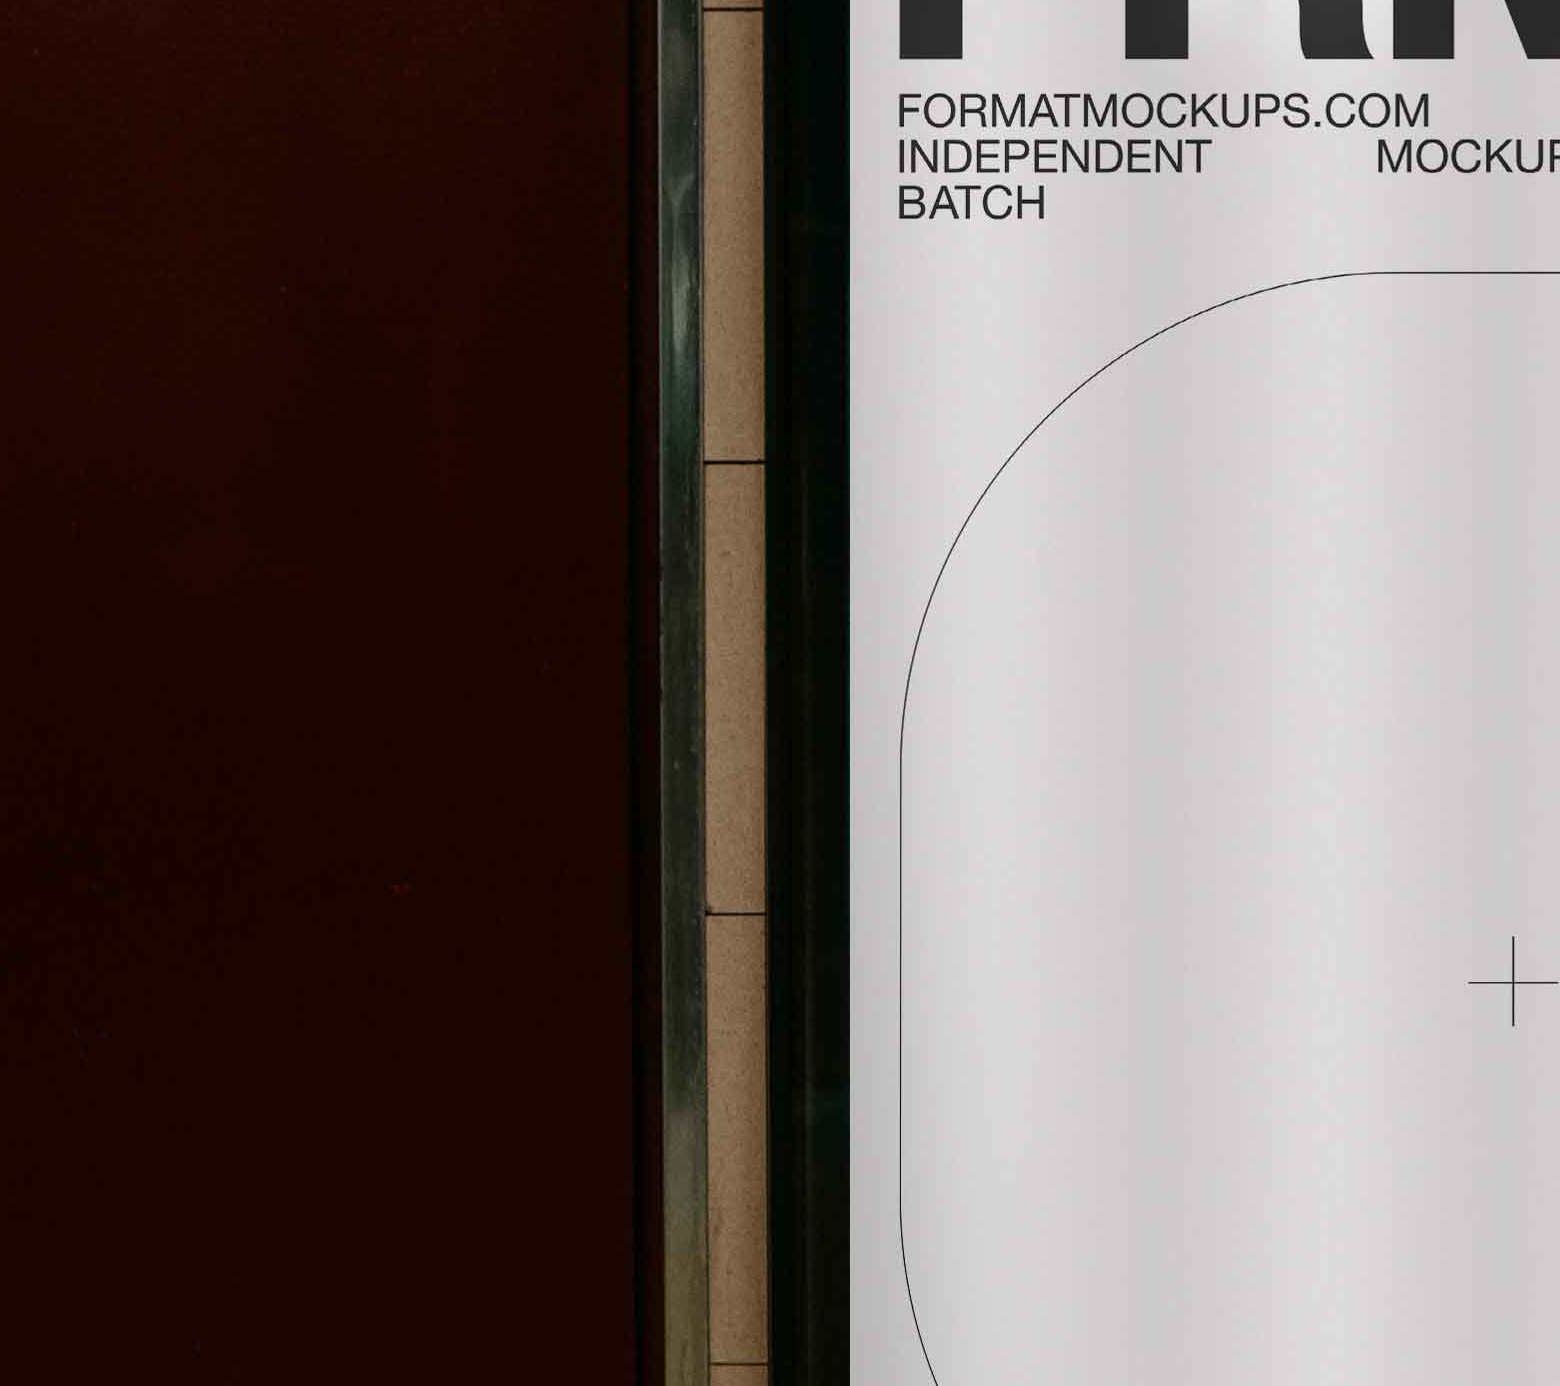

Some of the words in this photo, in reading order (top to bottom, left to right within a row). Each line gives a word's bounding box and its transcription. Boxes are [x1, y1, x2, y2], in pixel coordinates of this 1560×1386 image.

[899, 92, 1429, 129] FORMATMOCKUPS.COM
[899, 139, 1213, 174] INDEPENDENT
[898, 184, 1045, 220] BATCH
